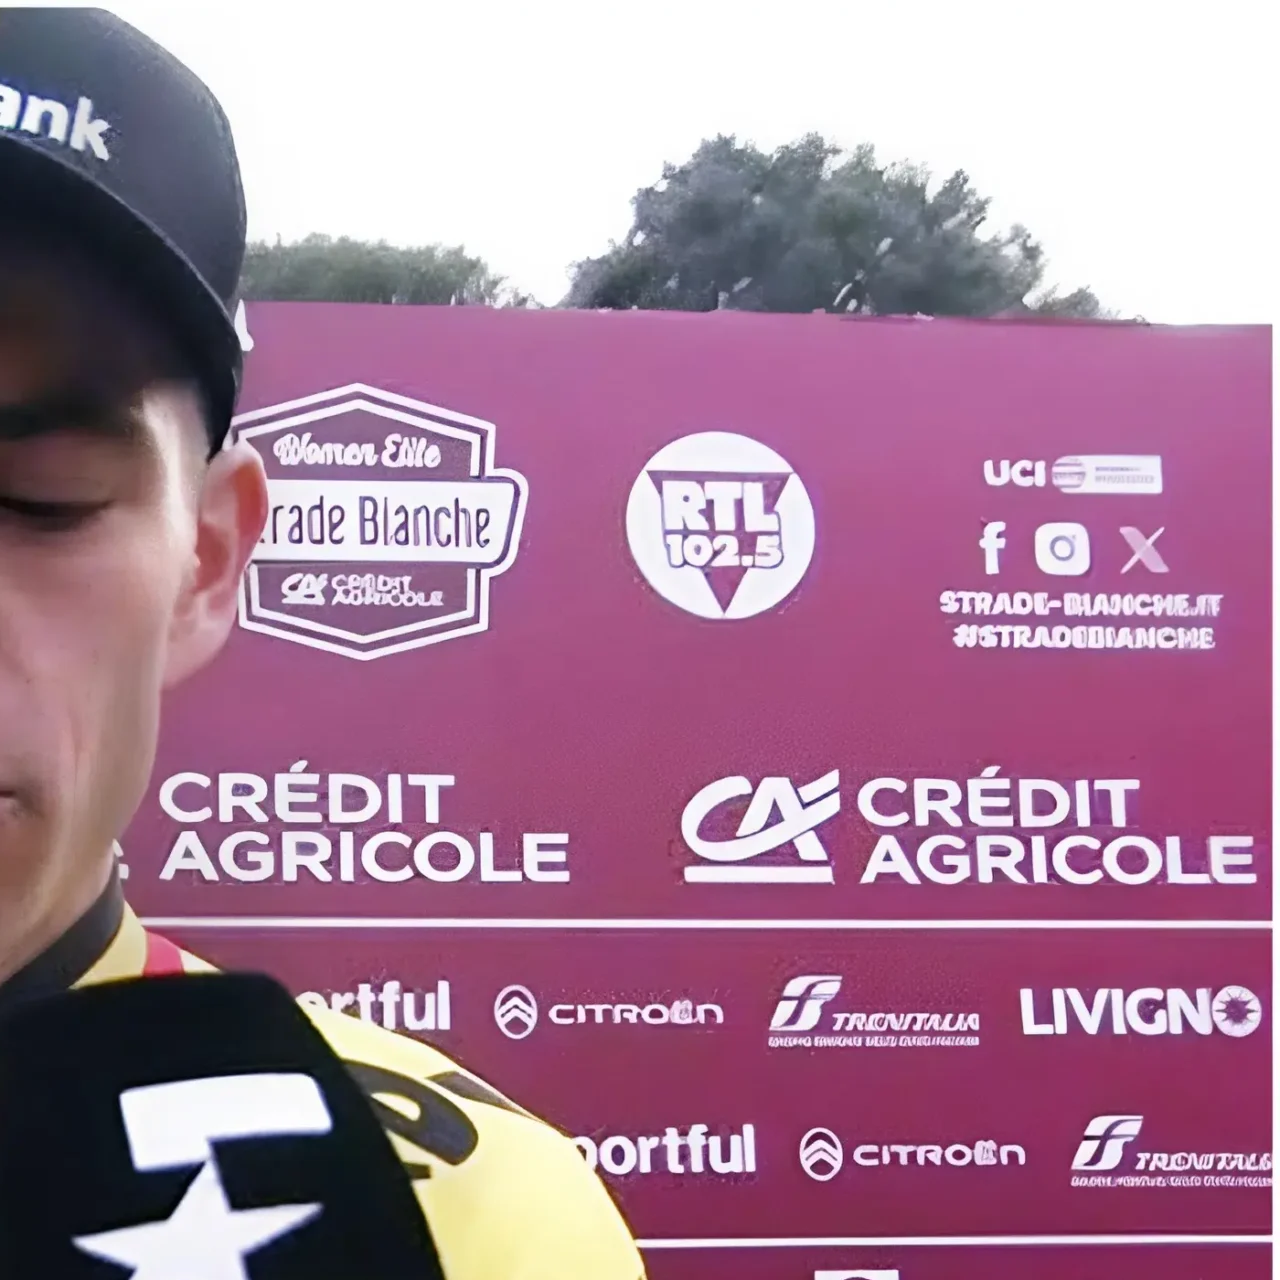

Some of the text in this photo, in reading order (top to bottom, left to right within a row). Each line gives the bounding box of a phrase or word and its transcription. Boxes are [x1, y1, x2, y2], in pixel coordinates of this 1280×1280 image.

[983, 459, 1046, 487] UCI
[260, 495, 490, 548] rade Blanche
[662, 480, 779, 531] RTL
[664, 533, 784, 569] 102.5
[159, 760, 456, 825] CRÉDIT
[858, 766, 1141, 830] CRÉDIT
[157, 831, 570, 886] AGRICOLE
[860, 833, 1257, 886] AGRICOLE
